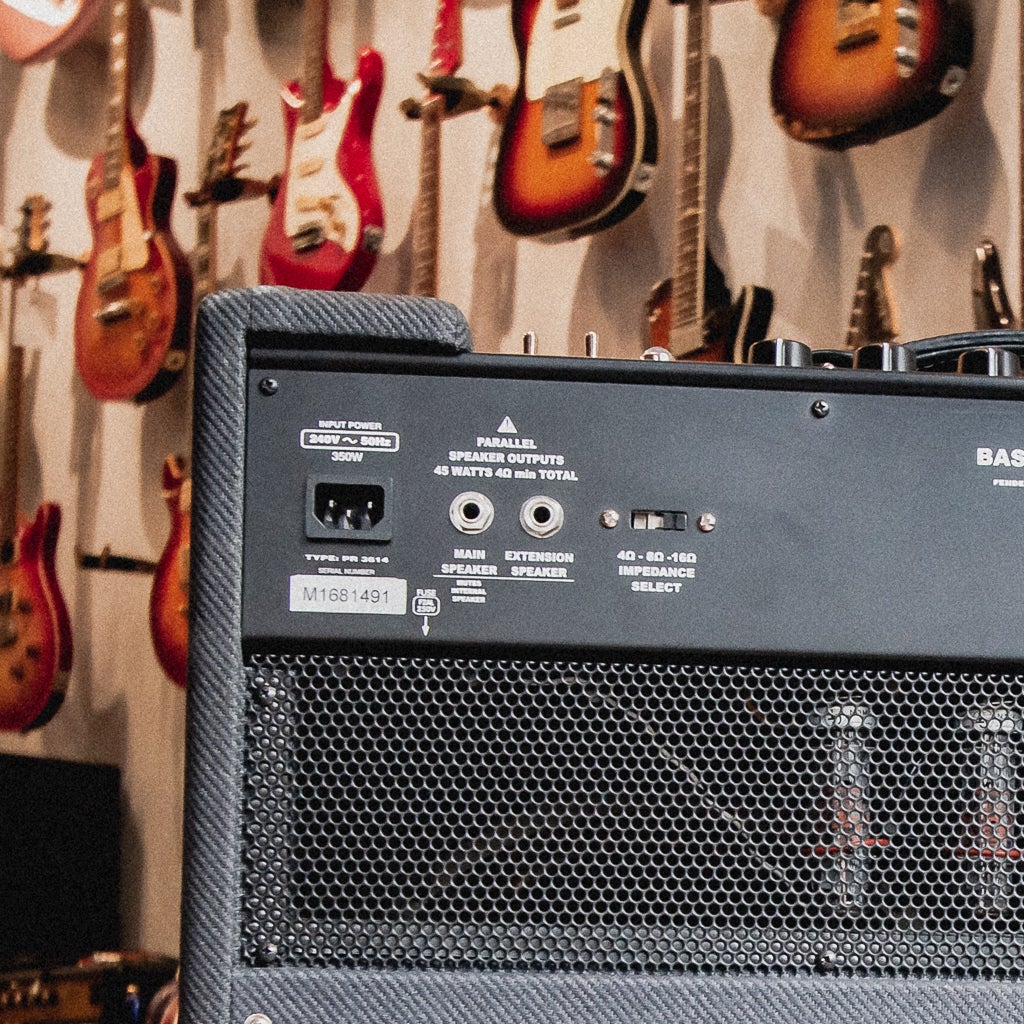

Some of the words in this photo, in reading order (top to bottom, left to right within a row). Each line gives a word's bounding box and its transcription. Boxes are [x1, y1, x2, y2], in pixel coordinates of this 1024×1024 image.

[318, 420, 346, 428] INPUT
[348, 421, 382, 430] POWER
[309, 434, 340, 444] 240V
[360, 436, 392, 446] 50Hz
[476, 436, 537, 449] PARALLEL
[331, 452, 363, 462] 350W
[448, 450, 505, 463] SPEAKER
[507, 453, 564, 466] OUTPUTS
[434, 465, 449, 476] 45
[450, 466, 493, 478] WATTS
[514, 469, 536, 479] min
[538, 470, 578, 481] TOTAL
[304, 554, 340, 562] TYPE:
[454, 548, 486, 560] MAIN
[504, 551, 574, 562] EXTENSION
[616, 550, 636, 560] 4Ω
[441, 564, 498, 576] SPEAKER
[510, 566, 568, 578] SPEAKER
[618, 566, 696, 578] IMPEDANCE
[416, 588, 436, 597] FUSE
[631, 581, 682, 592] SELECT
[303, 587, 388, 604] M1681491
